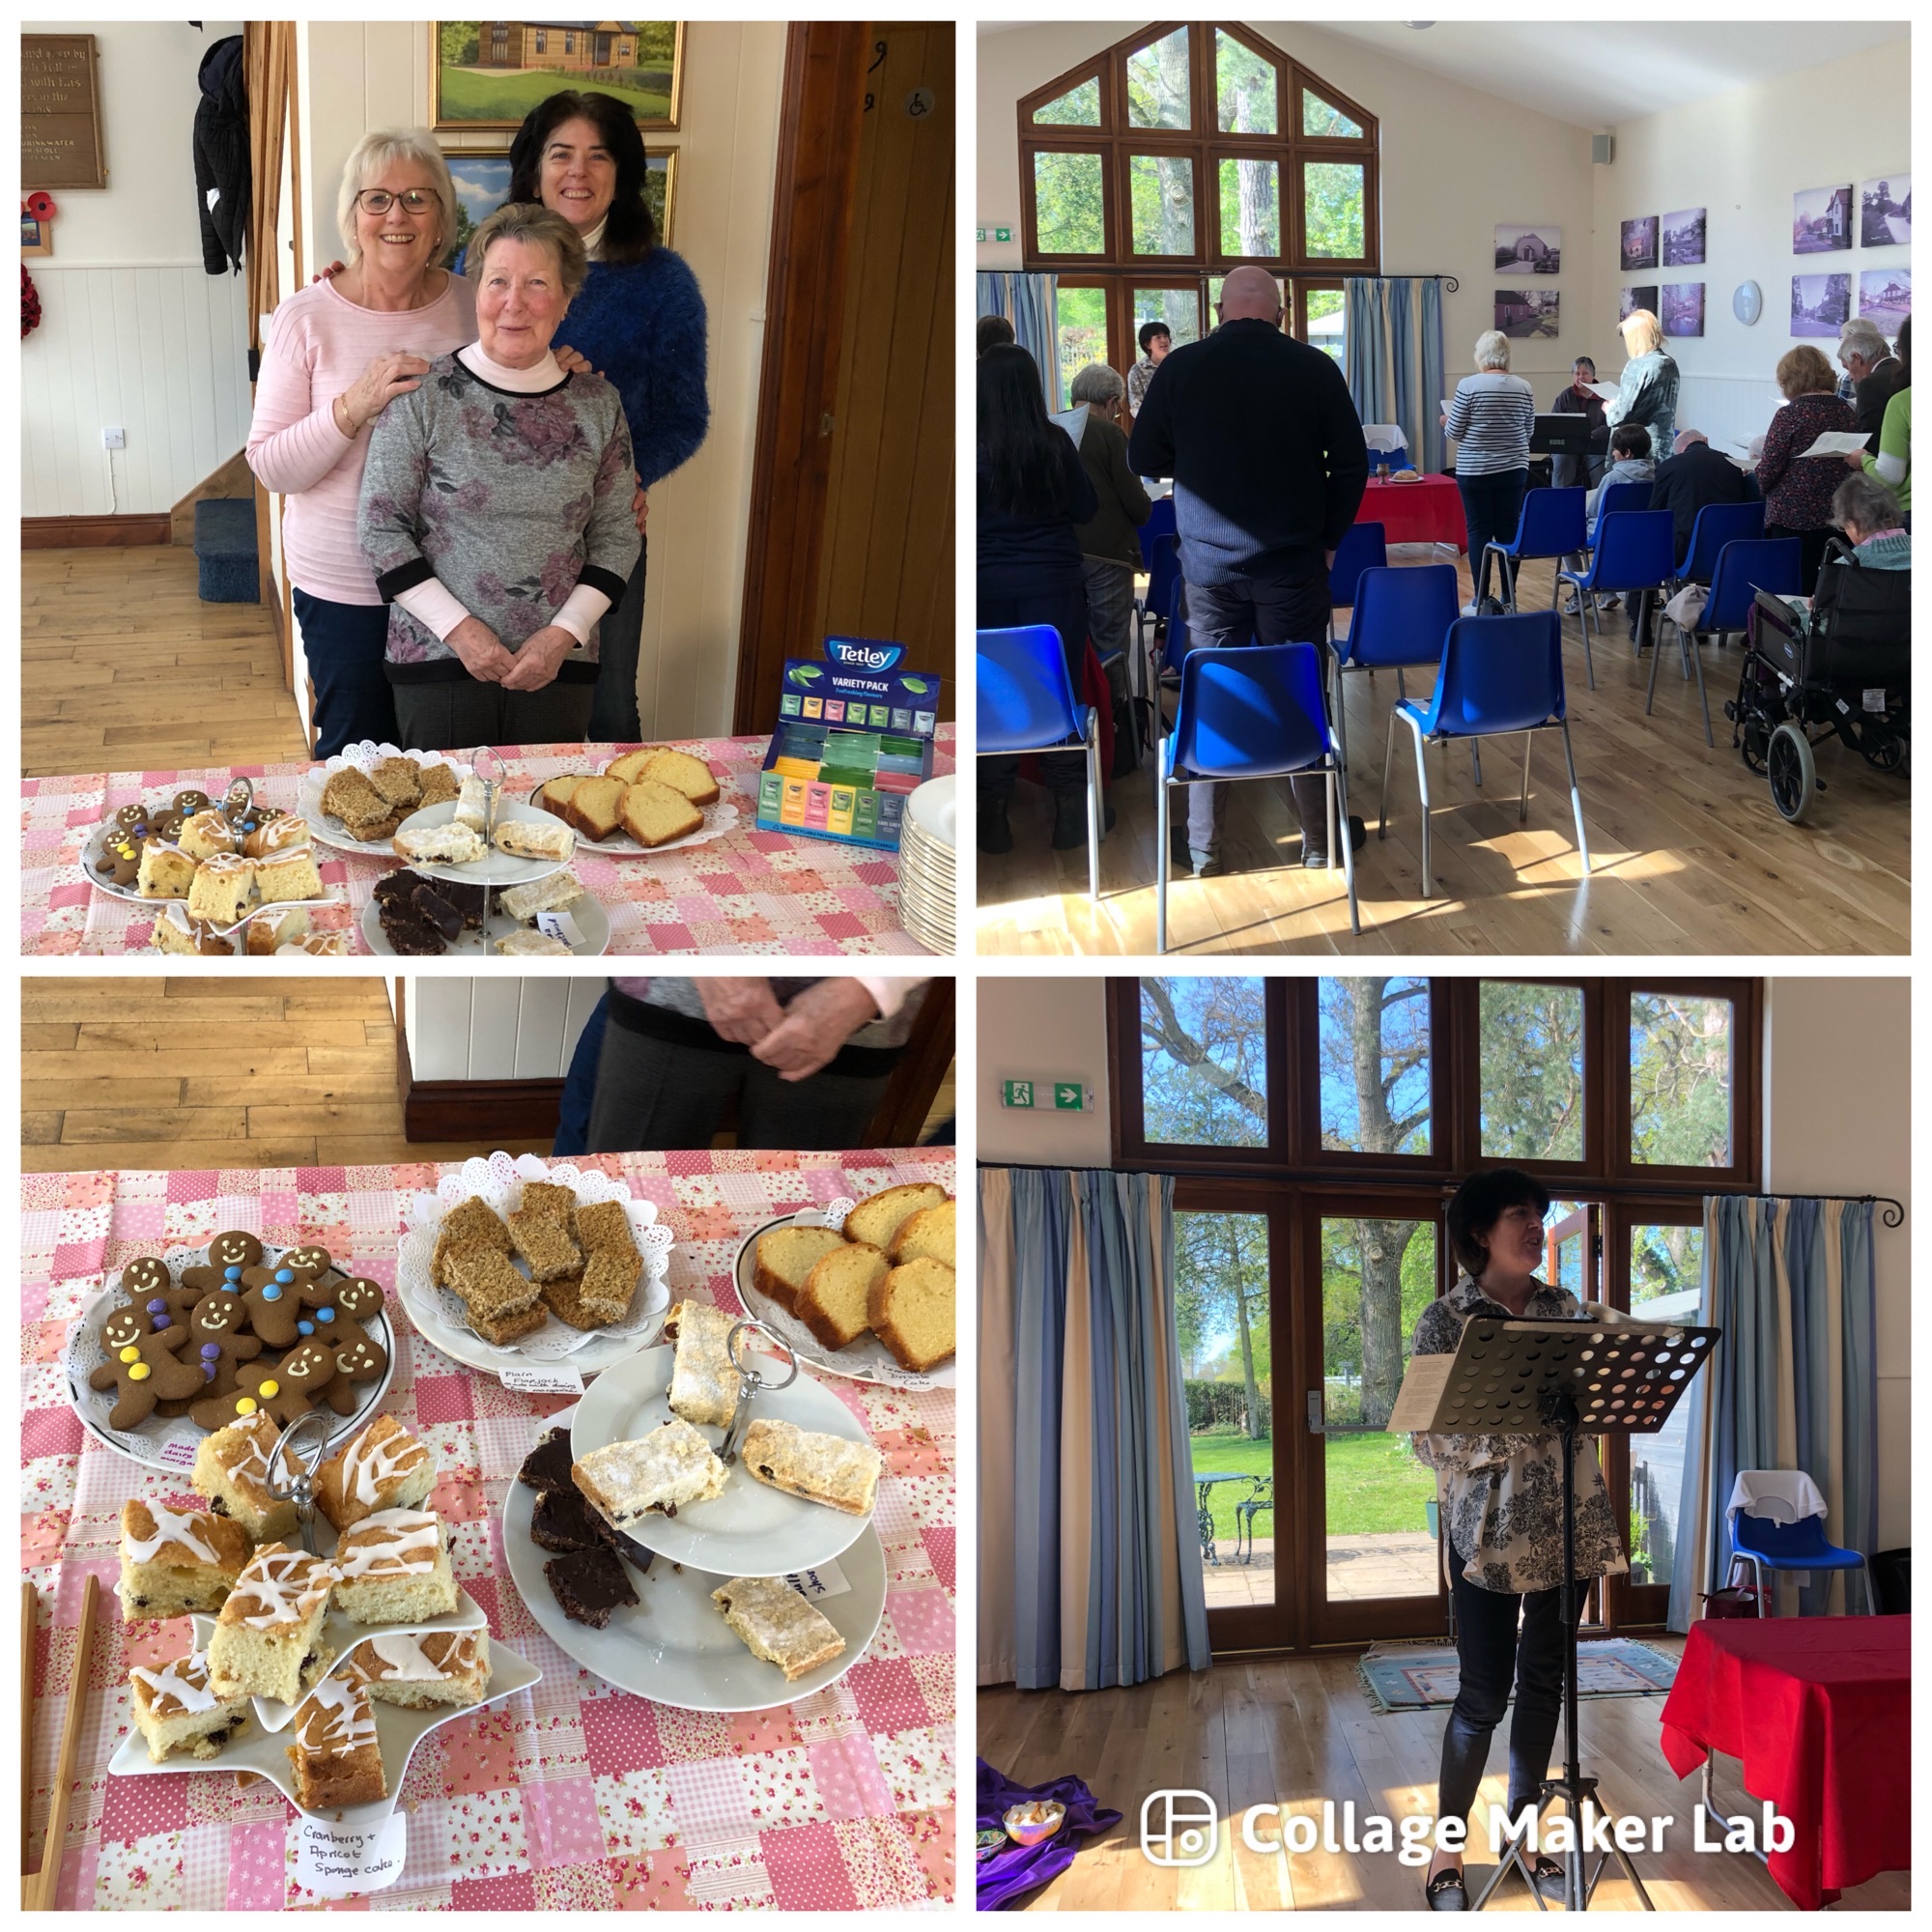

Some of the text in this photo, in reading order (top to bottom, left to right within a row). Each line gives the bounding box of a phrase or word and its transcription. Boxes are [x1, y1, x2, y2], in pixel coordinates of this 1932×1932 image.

[838, 645, 891, 668] Tetley
[832, 676, 889, 692] VARIETY PACK
[164, 1450, 192, 1459] dairy
[169, 1443, 195, 1451] Made
[304, 1826, 364, 1848] Cranberry
[309, 1845, 361, 1860] Apricot
[314, 1862, 359, 1878] Sponge
